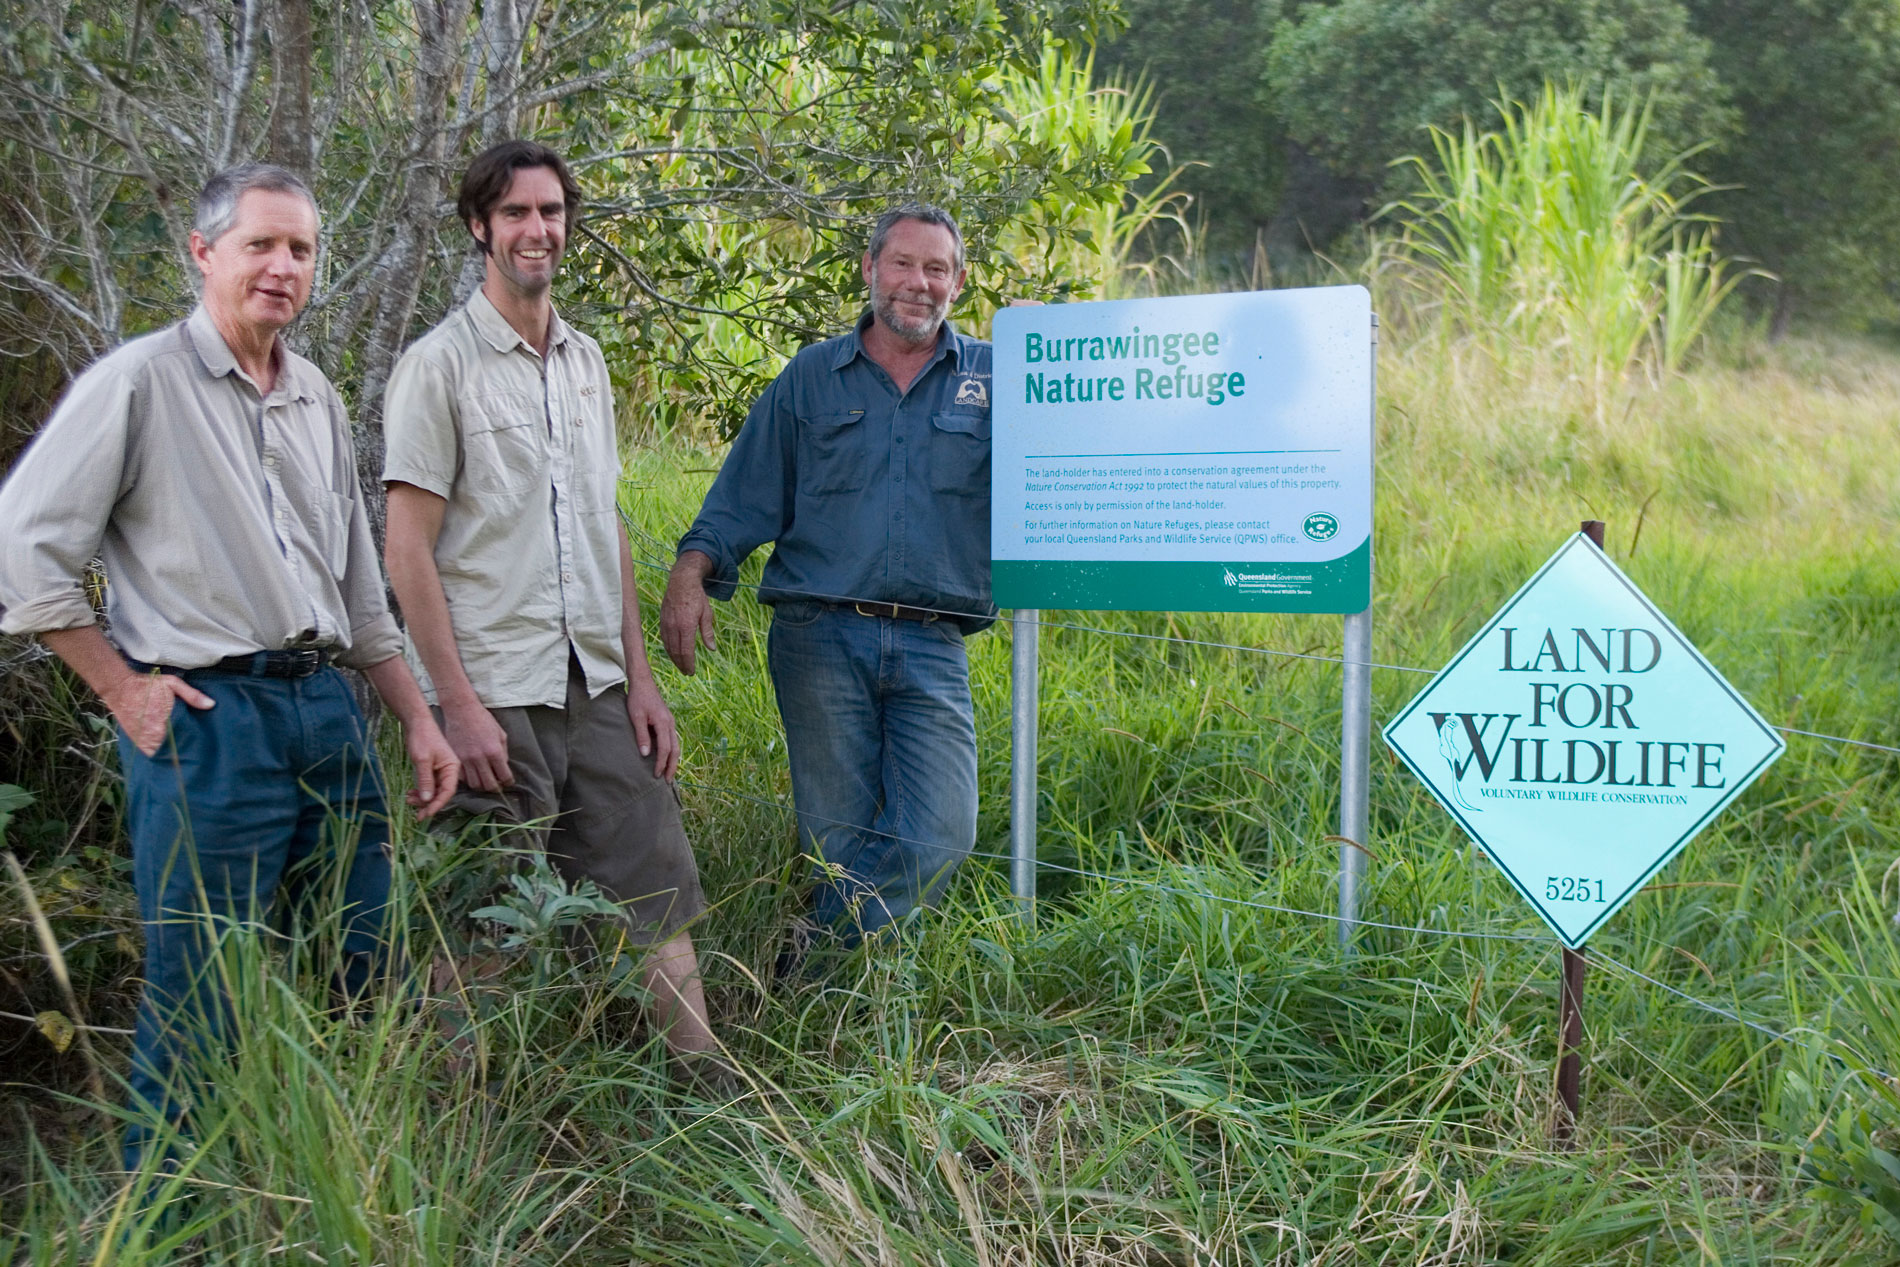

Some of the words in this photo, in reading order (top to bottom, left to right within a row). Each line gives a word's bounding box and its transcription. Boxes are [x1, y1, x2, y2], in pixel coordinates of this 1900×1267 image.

[1025, 326, 1219, 366] Burrawingee
[1025, 373, 1124, 404] Nature
[1136, 365, 1245, 406] Refuge
[1025, 468, 1040, 478] The
[1042, 468, 1090, 477] land-holder
[1092, 468, 1107, 477] has
[1110, 467, 1142, 476] entered
[1145, 467, 1161, 476] into
[1172, 466, 1228, 476] conservation
[1230, 466, 1279, 476] agreement
[1282, 465, 1308, 474] under
[1311, 464, 1326, 474] the
[1025, 482, 1052, 491] Nature
[1054, 482, 1107, 491] Conservation
[1109, 481, 1122, 490] Act
[1125, 482, 1144, 492] 1992
[1147, 482, 1155, 490] to
[1157, 481, 1187, 492] protect
[1189, 480, 1203, 490] the
[1206, 480, 1237, 489] natural
[1239, 480, 1268, 489] values
[1270, 479, 1280, 488] of
[1281, 479, 1298, 488] this
[1300, 479, 1341, 490] property.
[1025, 501, 1052, 510] Access
[1055, 501, 1062, 510] is
[1064, 501, 1082, 512] only
[1084, 501, 1094, 512] by
[1096, 501, 1143, 511] permission
[1146, 500, 1154, 510] of
[1156, 500, 1170, 509] the
[1173, 500, 1226, 509] land-holder.
[1025, 520, 1037, 529] For
[1039, 520, 1067, 529] further
[1070, 520, 1118, 529] information
[1134, 520, 1162, 529] Nature
[1165, 520, 1202, 531] Refuges,
[1204, 520, 1234, 531] please
[1236, 520, 1270, 529] contact
[1025, 536, 1042, 544] your
[1045, 534, 1064, 543] local
[1066, 534, 1117, 544] Queensland
[1120, 534, 1143, 543] Parks
[1145, 534, 1162, 543] and
[1164, 534, 1197, 543] Wildlife
[1200, 534, 1232, 543] Service
[1234, 534, 1268, 544] (QPWS)
[1270, 534, 1299, 544] office.
[1499, 628, 1662, 674] LAND
[1528, 682, 1639, 729] FOR
[1427, 712, 1726, 789] WILDLIFE
[1481, 788, 1543, 800] VOLUNTARY
[1547, 790, 1598, 801] WILDLIFE
[1602, 793, 1688, 805] CONSERVATION
[1546, 876, 1606, 902] 5251
